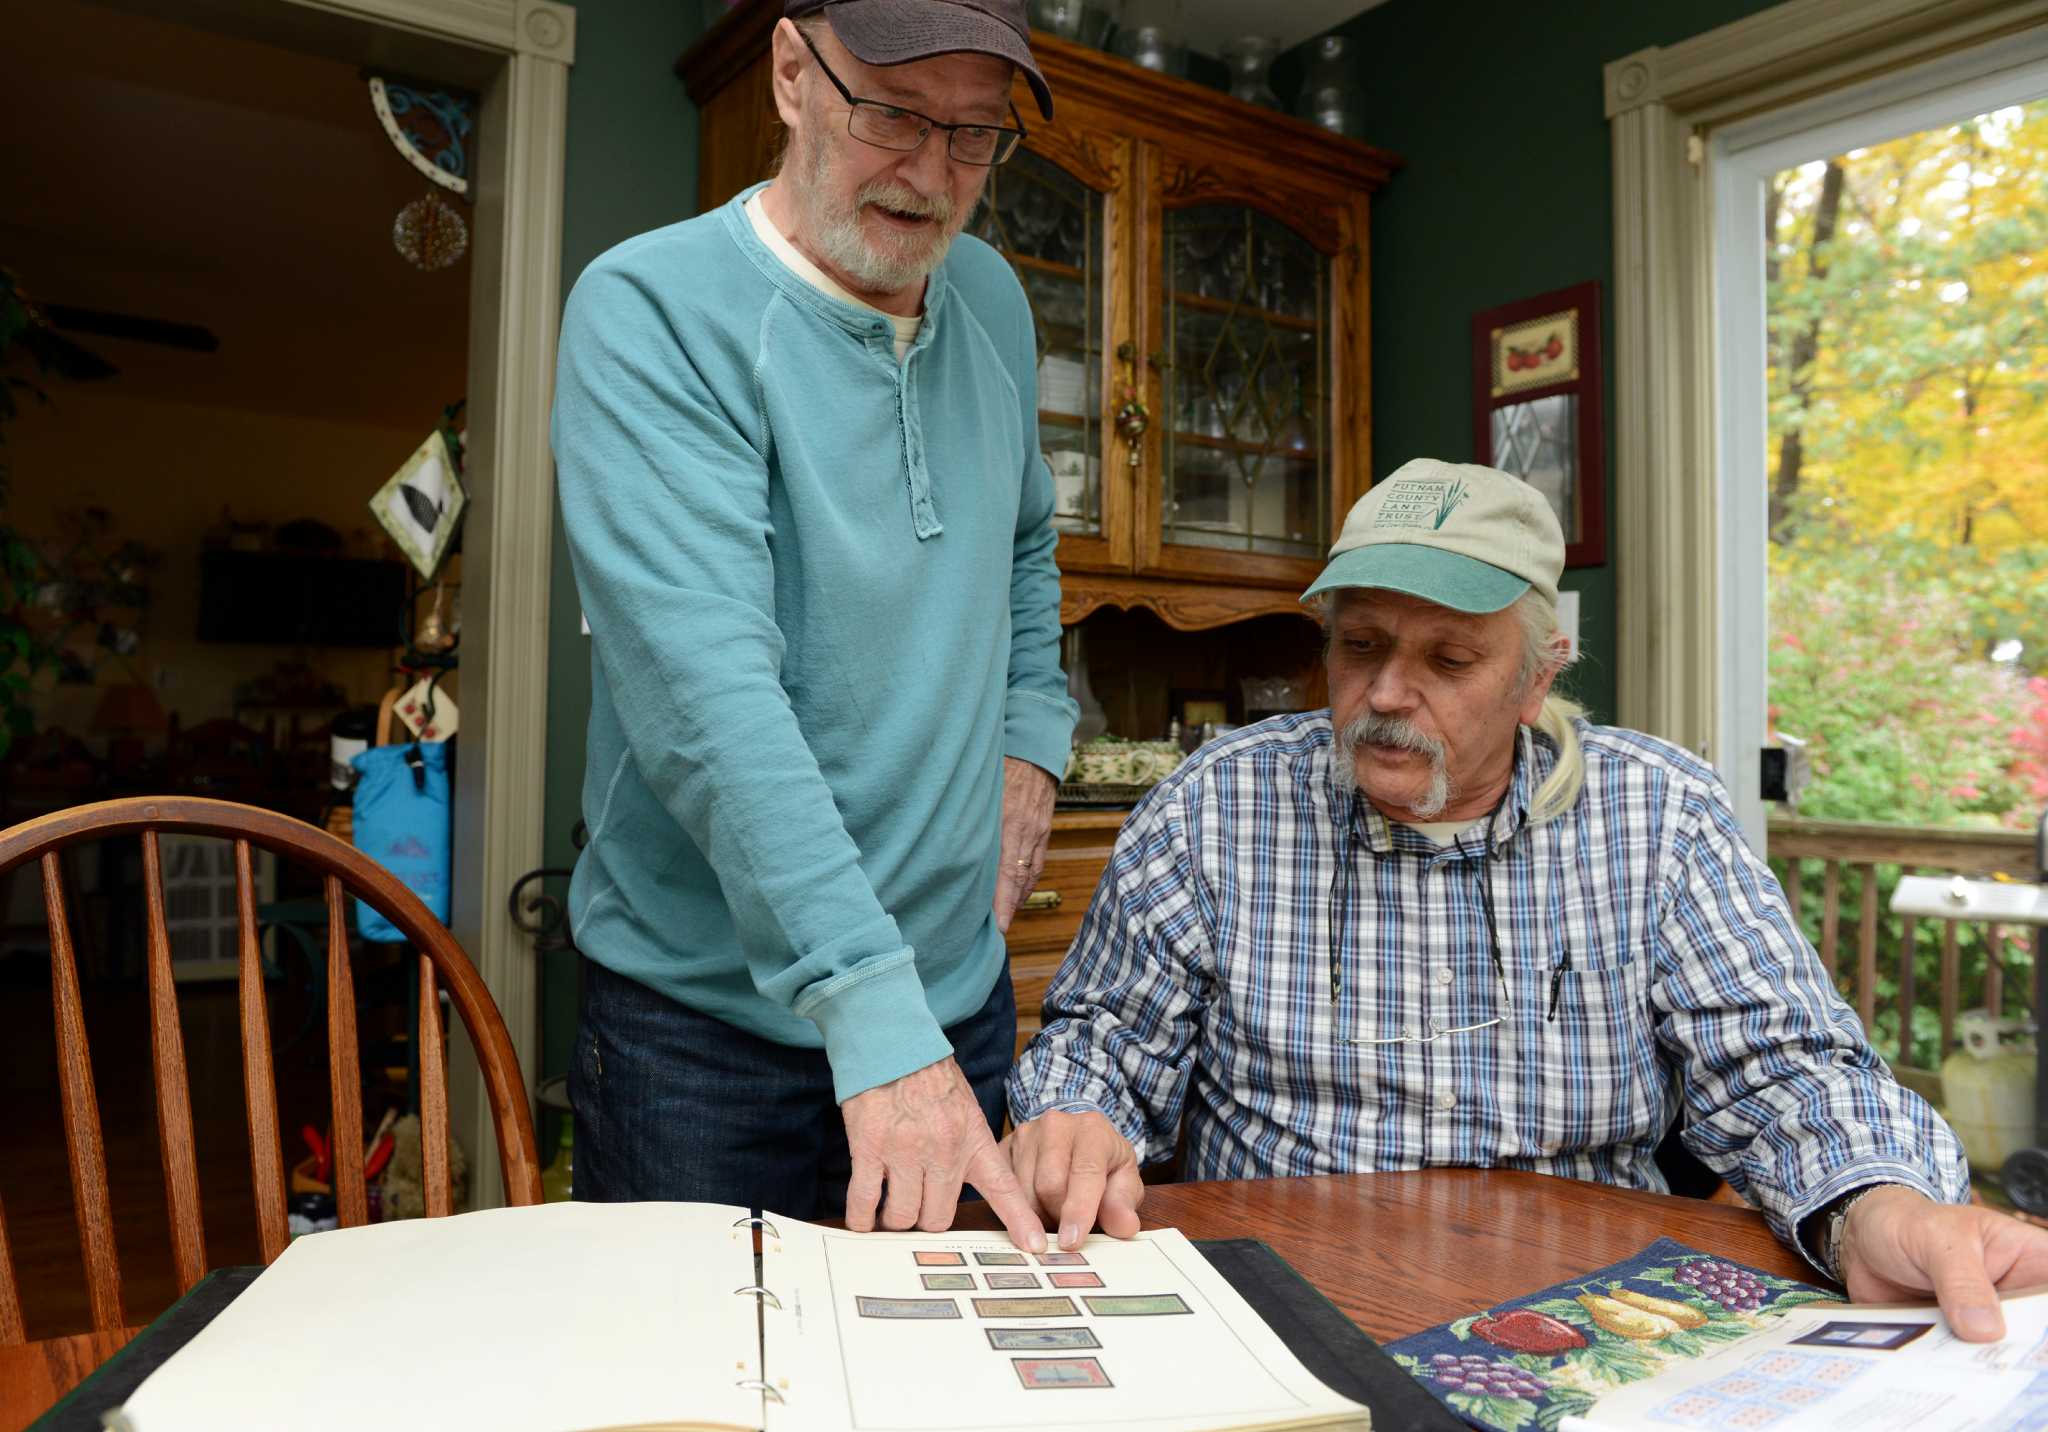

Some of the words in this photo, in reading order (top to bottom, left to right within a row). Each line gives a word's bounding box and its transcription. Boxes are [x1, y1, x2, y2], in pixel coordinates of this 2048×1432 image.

[1393, 483, 1445, 492] PUTNAM
[1387, 493, 1440, 502] COUNTY
[1382, 502, 1422, 511] LAND
[1377, 512, 1423, 520] TRUST
